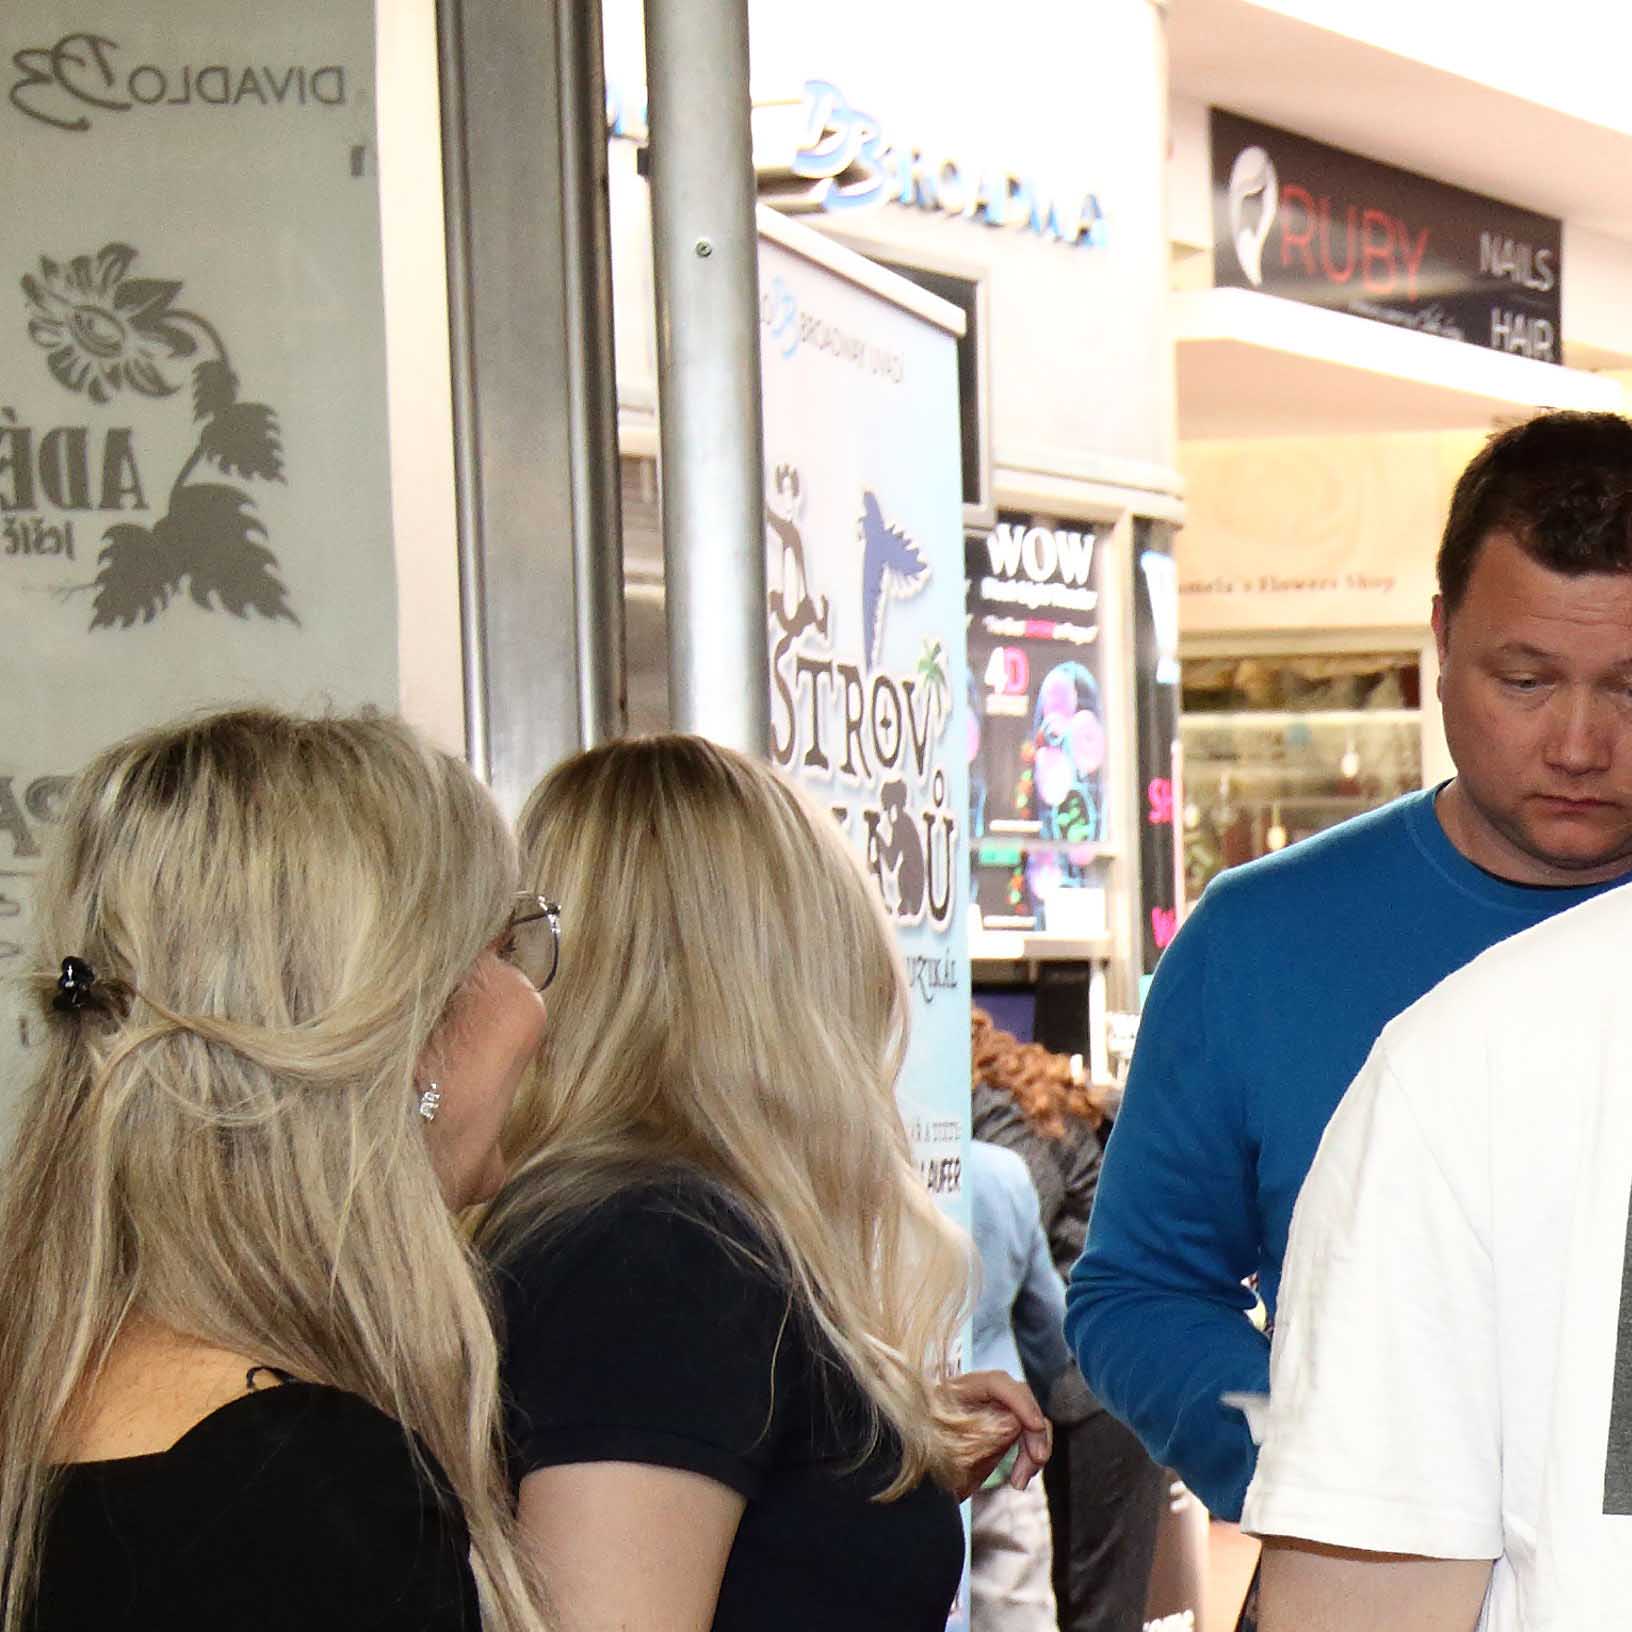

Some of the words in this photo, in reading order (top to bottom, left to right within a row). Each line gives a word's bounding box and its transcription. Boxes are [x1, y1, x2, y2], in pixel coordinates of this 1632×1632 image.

[1279, 183, 1431, 303] RUBY
[1479, 231, 1554, 292] NAILS
[1490, 307, 1556, 365] HAIR
[985, 522, 1097, 586] WOW
[770, 638, 945, 778] STROV
